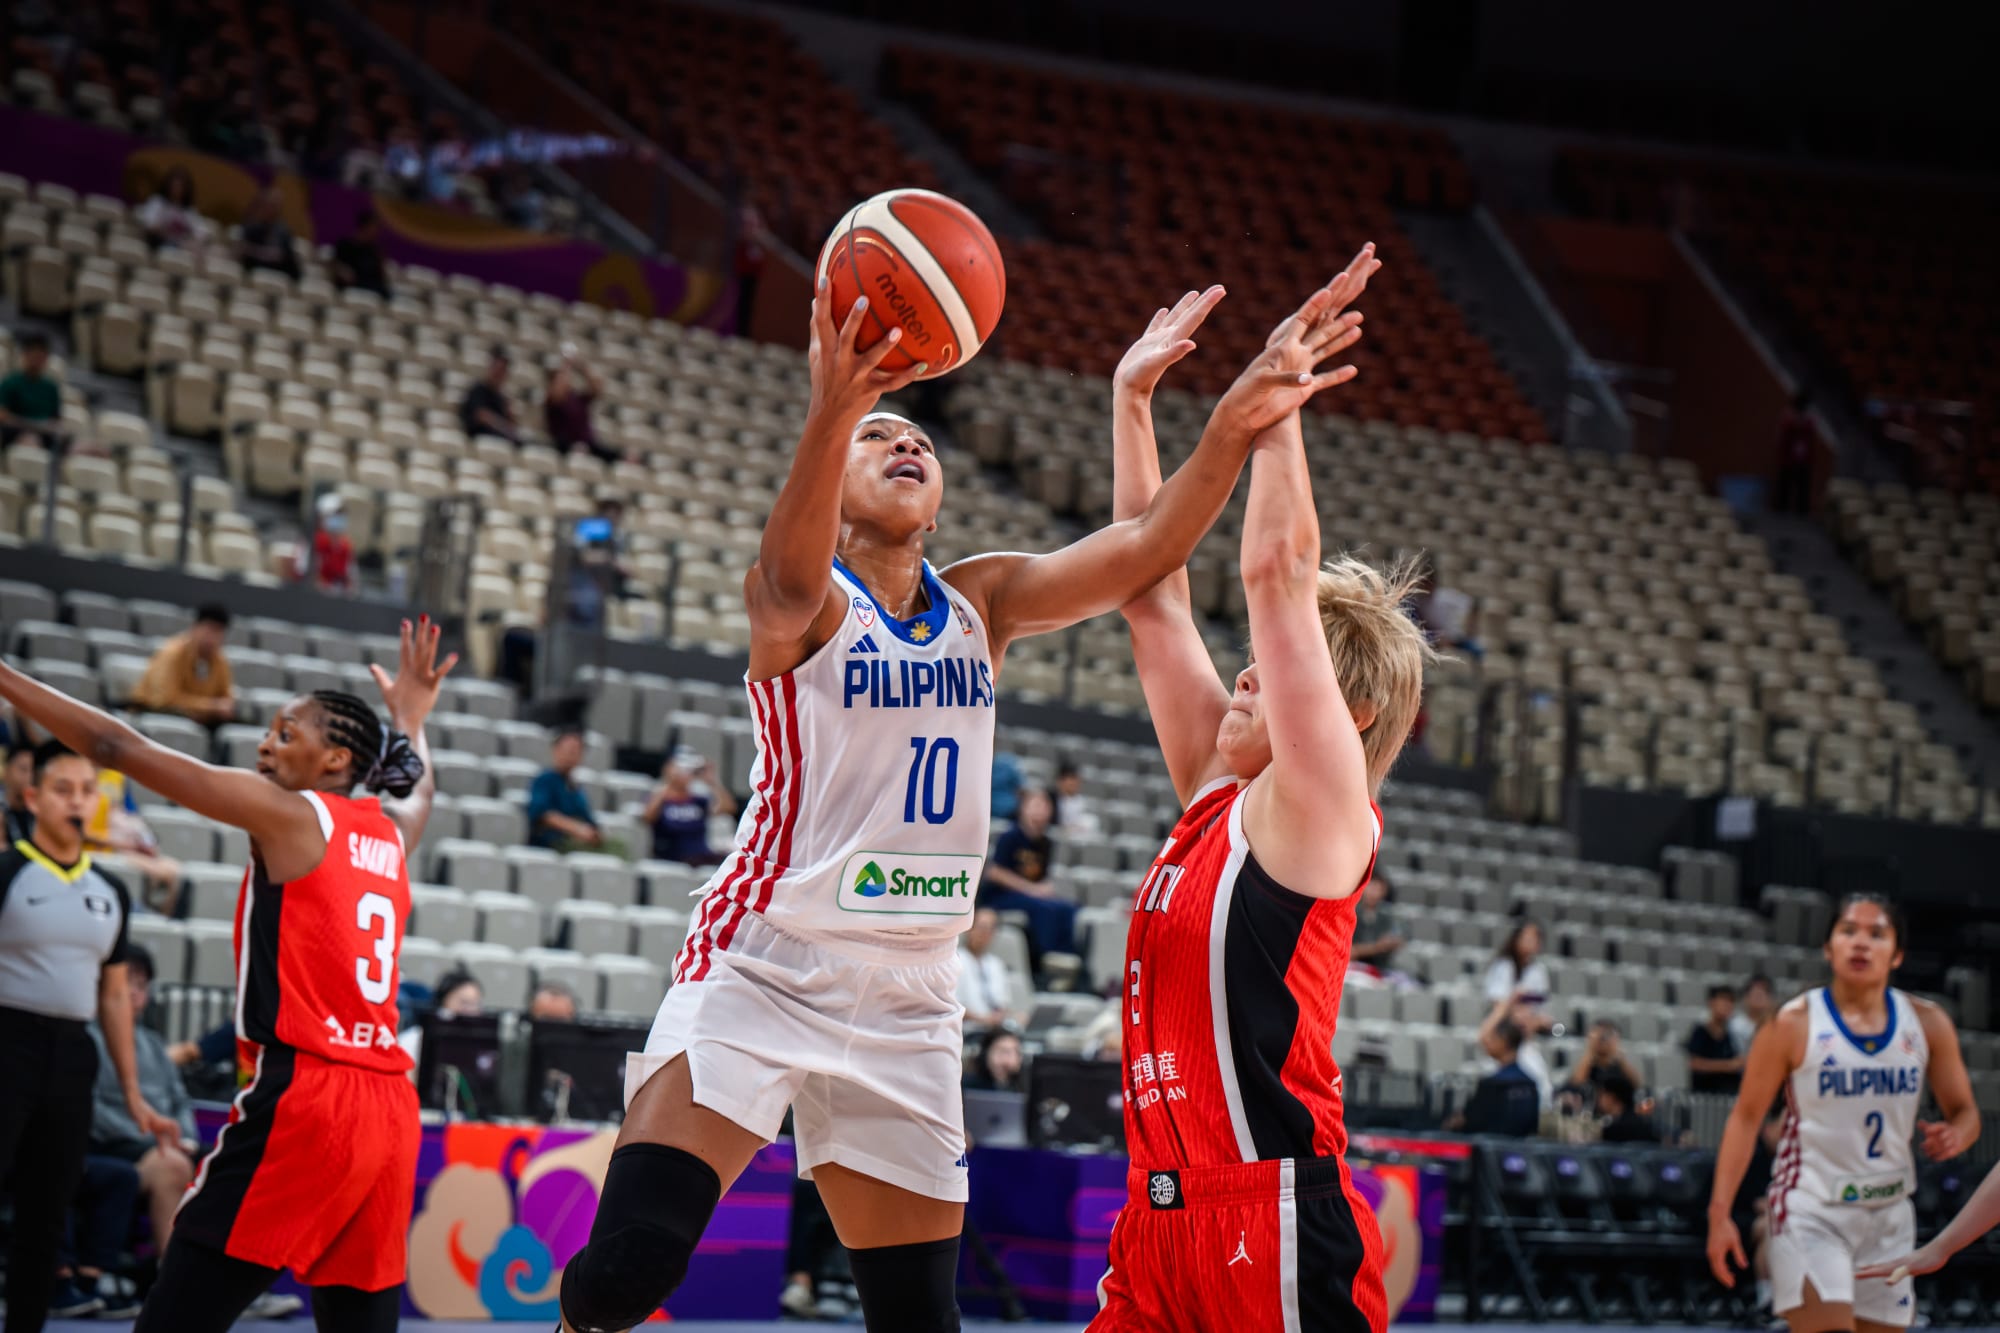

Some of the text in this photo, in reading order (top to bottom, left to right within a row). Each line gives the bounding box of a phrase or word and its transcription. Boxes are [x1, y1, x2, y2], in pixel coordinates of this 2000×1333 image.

[875, 273, 932, 346] molten
[844, 657, 993, 709] PILIPINAS
[904, 737, 960, 825] 10
[889, 867, 971, 899] Smart
[355, 891, 396, 1005] 3
[1819, 1067, 1918, 1097] PILIPINAS
[1865, 1110, 1883, 1158] 2
